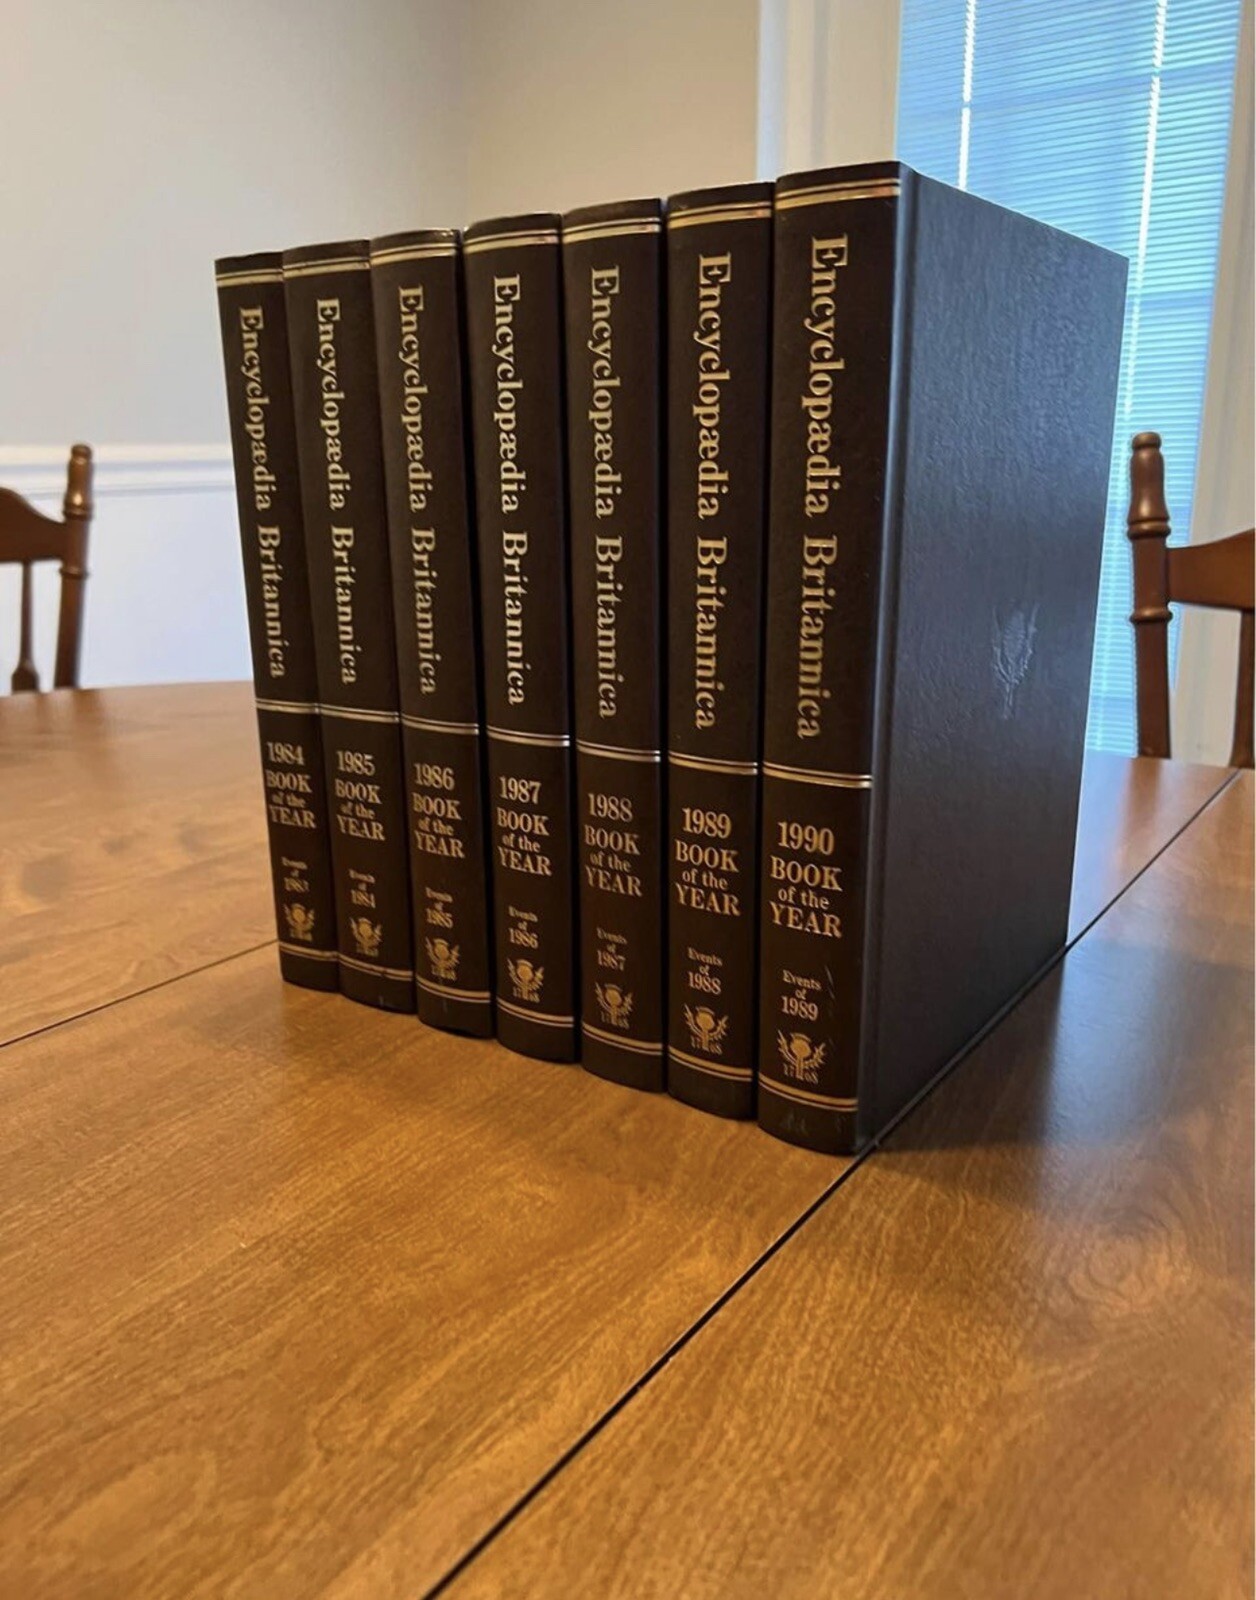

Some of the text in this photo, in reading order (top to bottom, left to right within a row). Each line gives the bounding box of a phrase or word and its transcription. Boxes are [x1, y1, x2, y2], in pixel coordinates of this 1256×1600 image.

[238, 305, 288, 679] Encyclopædia Britannica
[316, 298, 363, 685] Encyclopædia Britannica
[398, 285, 442, 695] Encyclopædia Britannica
[492, 274, 532, 706] Encyclopædia Britannica
[587, 265, 625, 720] Encyclopædia Britannica
[692, 252, 732, 730] Encyclopædia Britannica
[796, 234, 849, 740] Encyclopædia Britannica
[266, 741, 305, 766] 1984
[336, 750, 376, 776] 1985
[266, 769, 313, 793] BOOK
[334, 778, 382, 804] BOOK
[413, 763, 455, 791] 1986
[499, 776, 541, 804] 1987
[269, 806, 317, 829] YEAR
[412, 792, 462, 821] BOOK
[588, 793, 634, 823] 1988
[336, 814, 386, 841] YEAR
[497, 806, 549, 836] BOOK
[682, 807, 733, 840] 1989
[414, 831, 466, 859] YEAR
[502, 833, 541, 853] of the
[584, 824, 640, 855] BOOK
[778, 821, 834, 856] 1990
[498, 846, 552, 877] YEAR
[590, 852, 631, 873] of the
[674, 839, 740, 873] BOOK
[585, 865, 643, 898] YEAR
[682, 868, 728, 891] of the
[770, 855, 843, 892] BOOK
[674, 882, 741, 917] YEAR
[778, 887, 830, 911] of the
[769, 901, 842, 939] YEAR
[509, 928, 539, 950] 1986
[597, 950, 626, 972] 1987
[687, 946, 723, 967] Events
[687, 972, 722, 995] 1988
[782, 969, 822, 991] Events
[781, 996, 819, 1022] 1989
